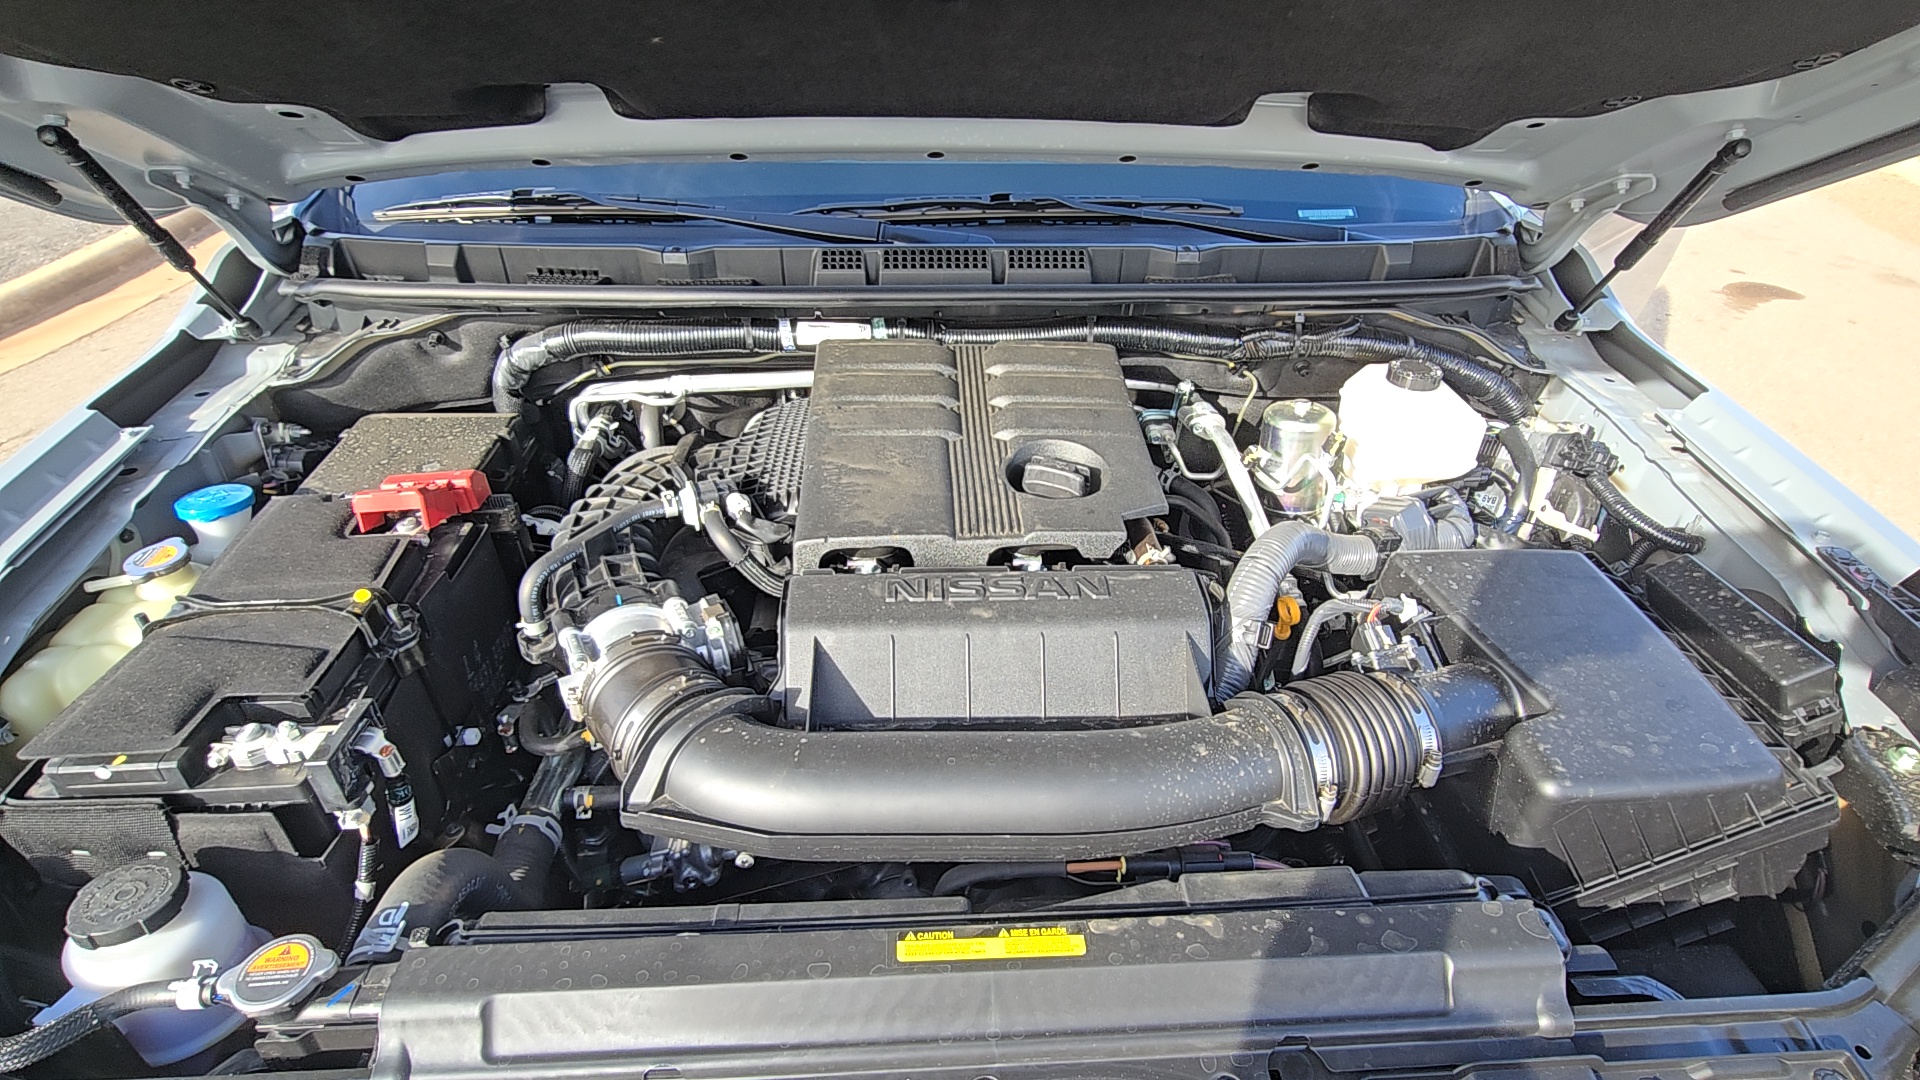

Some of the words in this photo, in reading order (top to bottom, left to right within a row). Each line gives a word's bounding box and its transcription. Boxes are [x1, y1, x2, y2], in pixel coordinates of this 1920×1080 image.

[885, 576, 1112, 602] NISSAN
[916, 931, 955, 941] CAUTION
[1009, 928, 1029, 937] MISE
[1029, 927, 1041, 937] EN
[1041, 927, 1068, 936] GARDE
[264, 955, 300, 963] WARNING
[252, 961, 305, 969] AVERTISSEMENT
